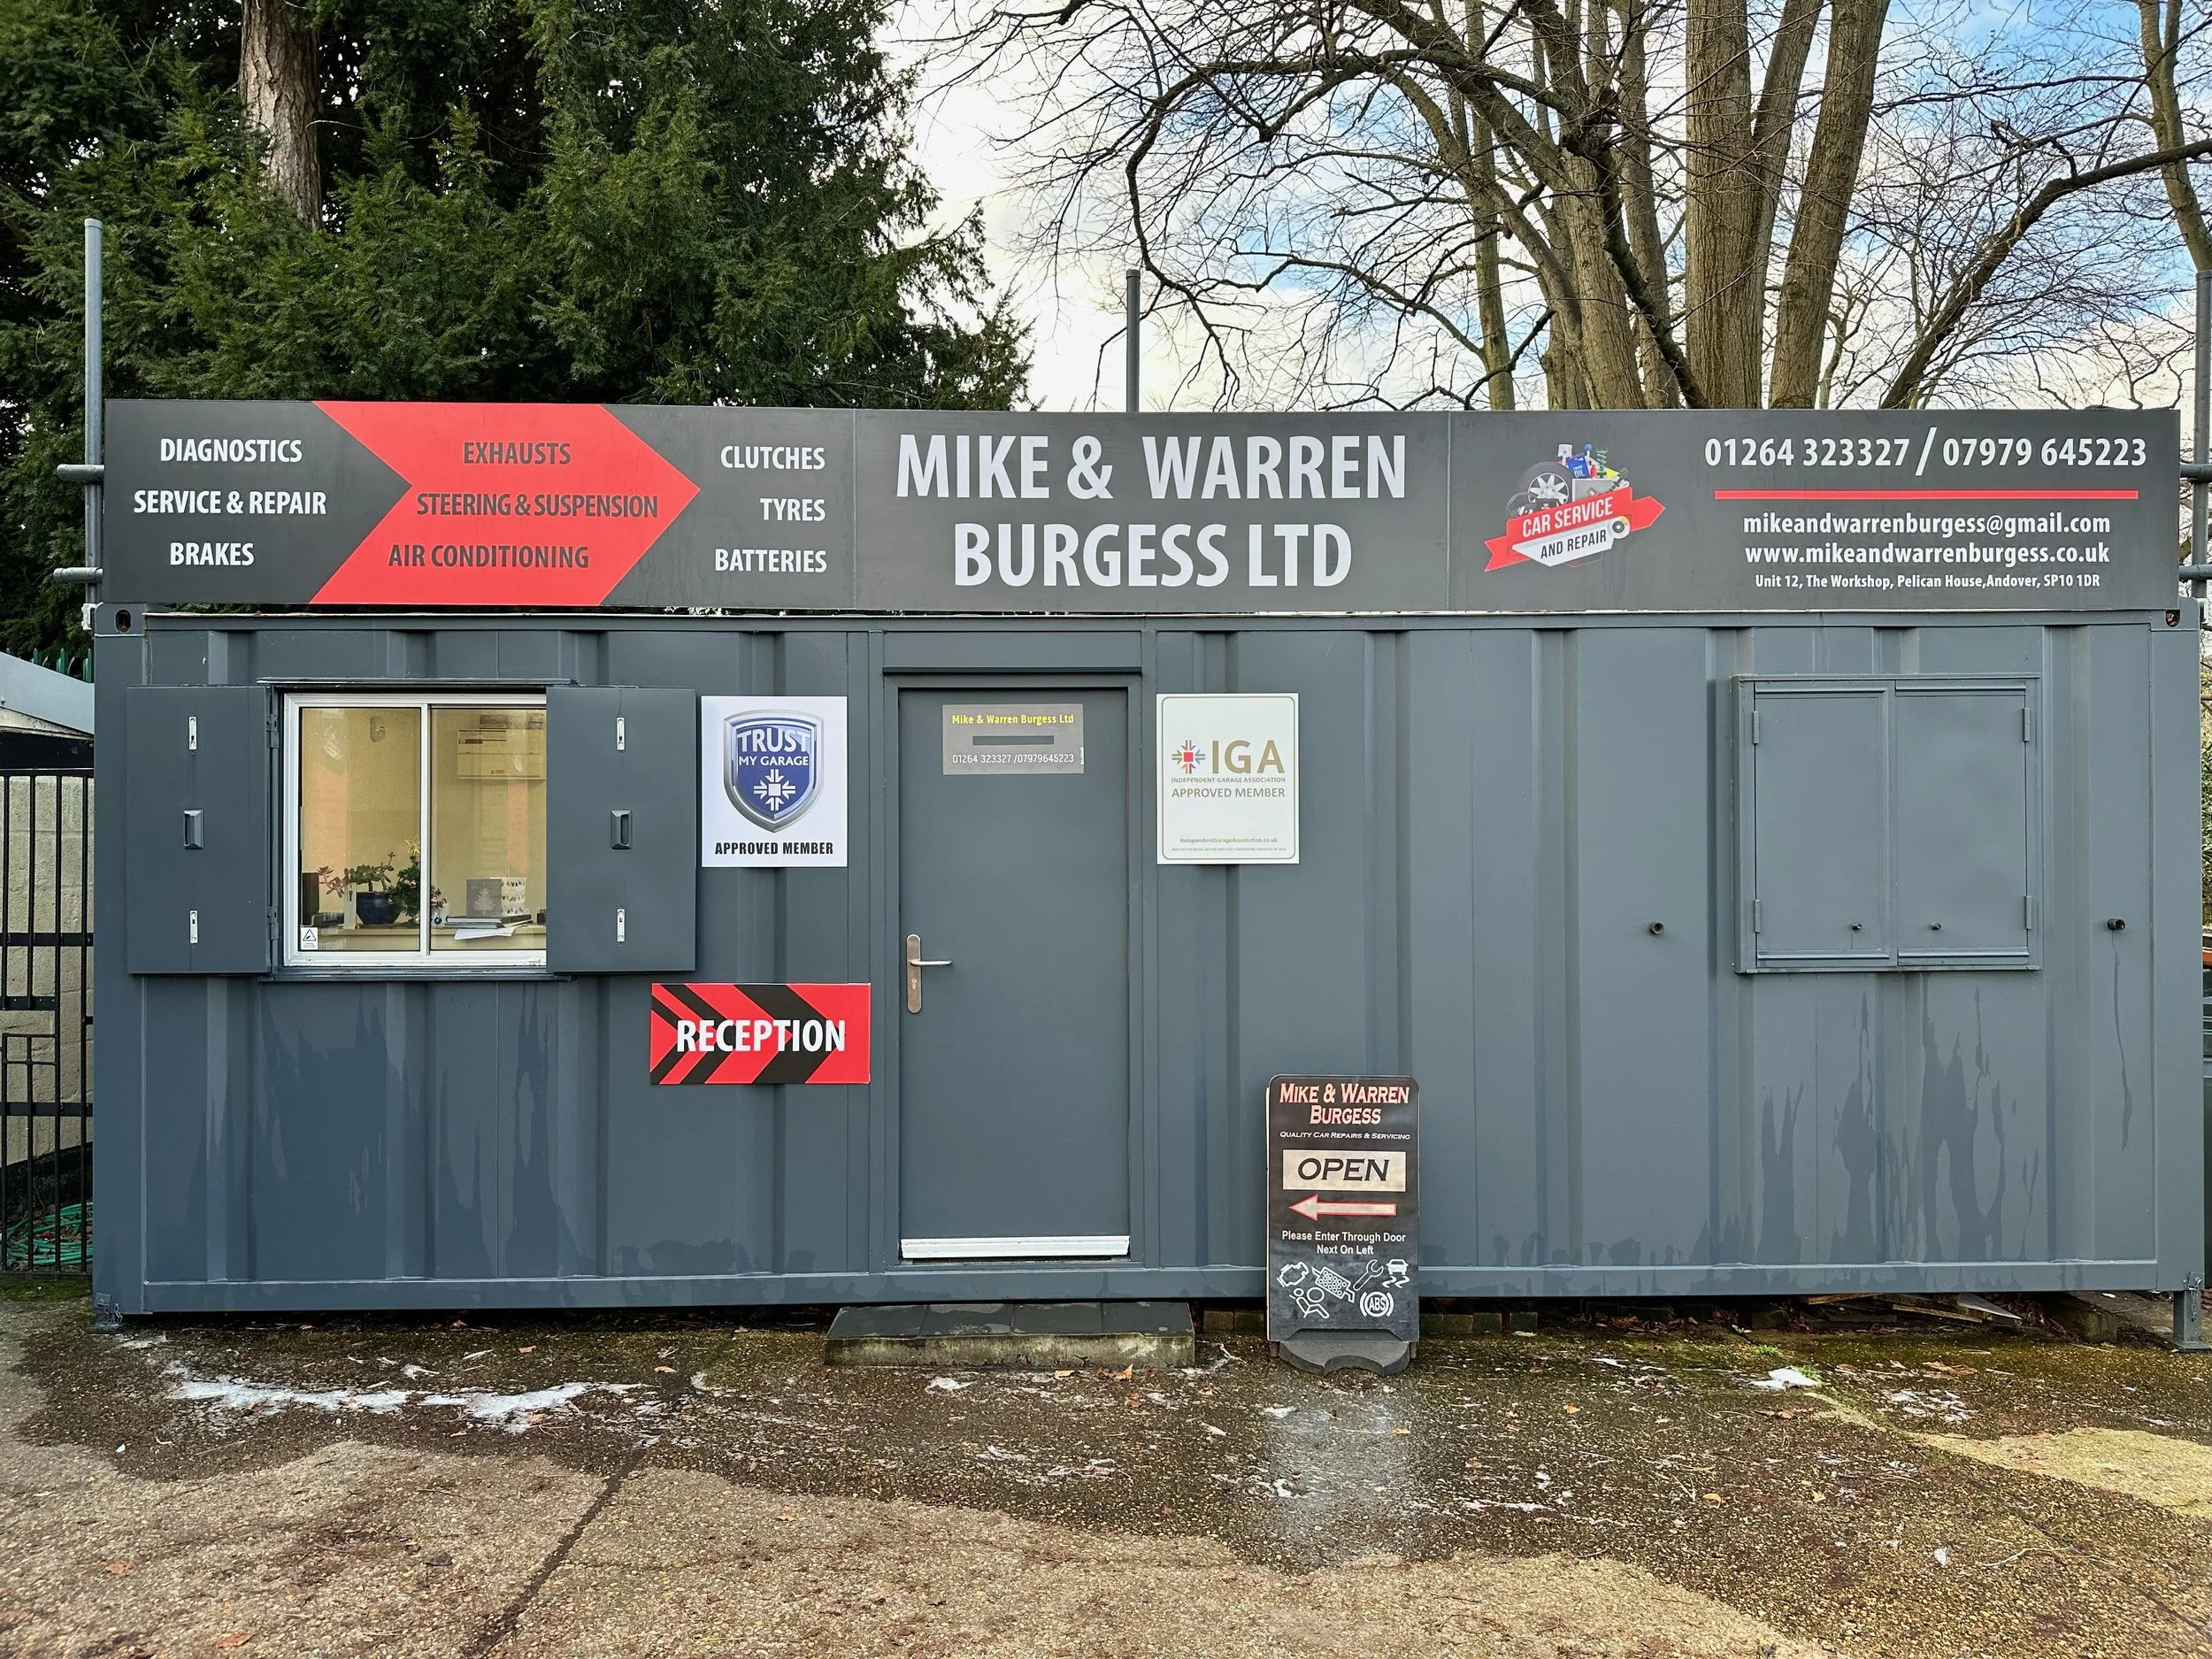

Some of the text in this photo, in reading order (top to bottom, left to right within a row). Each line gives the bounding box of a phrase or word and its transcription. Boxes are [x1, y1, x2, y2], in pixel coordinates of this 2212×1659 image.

[160, 437, 303, 465] DIAGNOSTICS
[464, 442, 572, 466] EXHAUSTS
[720, 445, 826, 471] CLUTCHES
[1705, 426, 2147, 476] 01264 323327 / 07979 645223
[896, 434, 1405, 500] MIKE & WARREN
[1574, 469, 1585, 478] OIL
[134, 489, 327, 516] SERVICE & REPAIR
[417, 492, 659, 518] STEERING & SUSPENSION
[759, 497, 826, 523] TYRES
[1523, 496, 1613, 538] CAR SERVICE
[1743, 511, 2110, 539] mikeandwarrenburgess@gmail.com
[169, 541, 255, 567] BRAKES
[388, 543, 590, 570] AIR CONDITIONING
[955, 523, 1352, 588] BURGESS LTD
[1540, 529, 1607, 559] AND REPAIR
[1745, 541, 2109, 568] www.mikeandwarrenburgess.co.uk
[714, 548, 827, 573] BATTERIES
[1755, 574, 2100, 590] Unit 12, The Workshop, Pelican House,Andover, SP10 1DR
[952, 714, 1074, 726] Mike & Warren Burgess Ltd
[737, 727, 810, 753] TRUST
[739, 757, 809, 766] MY GARAGE
[952, 755, 979, 764] 01264
[980, 755, 1011, 764] 323327
[1212, 740, 1285, 774] IGA
[1171, 787, 1285, 797] APPROVED MEMBER
[715, 842, 833, 855] APPROVED MEMBER
[677, 1020, 845, 1052] RECEPTION
[1279, 1083, 1409, 1104] MIKE & WARREN
[1310, 1105, 1381, 1125] BURGESS
[1298, 1158, 1390, 1181] OPEN
[1282, 1231, 1406, 1243] Please Enter Through Door
[1317, 1245, 1373, 1255] Next On Left
[1369, 1297, 1386, 1311] ABS
